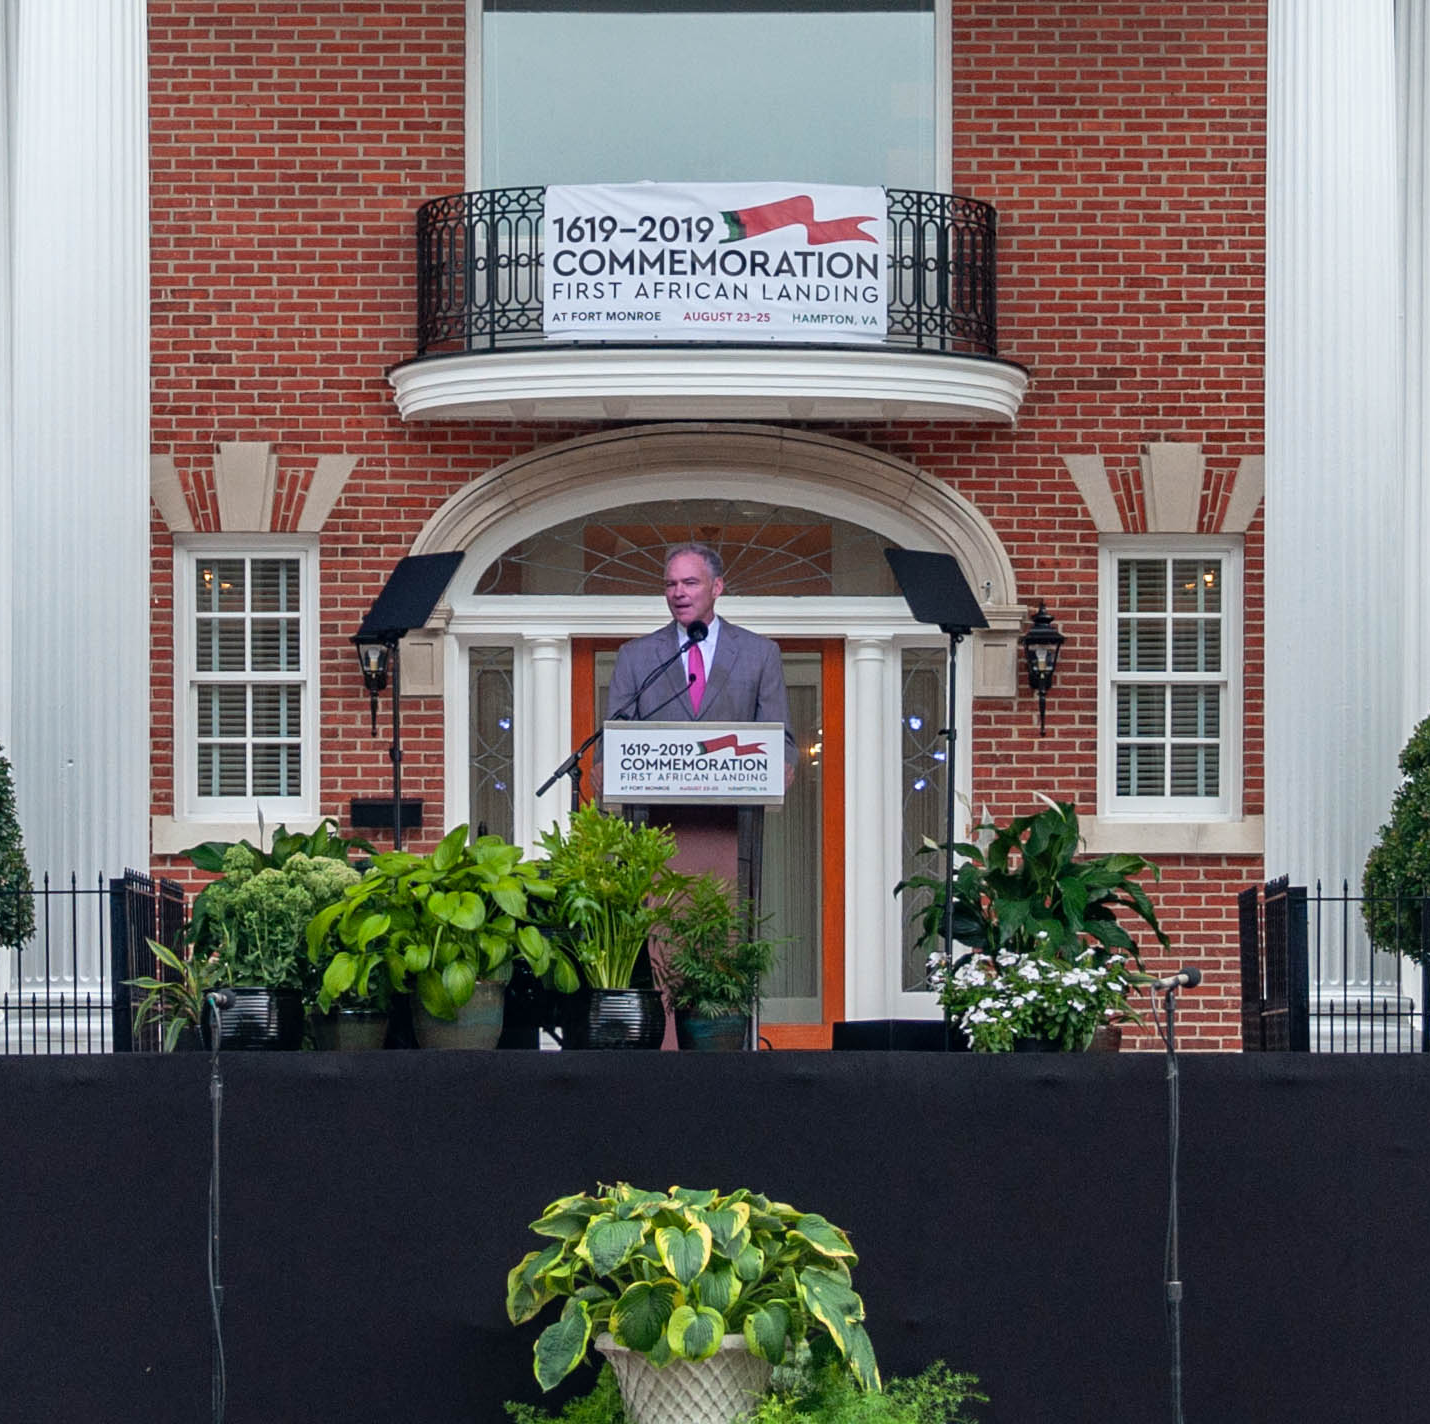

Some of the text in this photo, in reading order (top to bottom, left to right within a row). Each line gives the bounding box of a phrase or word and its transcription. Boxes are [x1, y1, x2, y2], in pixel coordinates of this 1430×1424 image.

[552, 215, 714, 243] 1619-2019
[552, 248, 879, 280] COMMEMORATION
[552, 281, 879, 303] FIRST AFRICAN LANDING
[552, 311, 662, 322] AT FORT MONROE
[683, 311, 771, 323] AUGUST 23-25
[792, 313, 878, 325] HAMPTON, VA
[620, 743, 694, 756] 1619-2019
[620, 758, 768, 771] COMMEMORATION
[620, 772, 768, 782] FIRST AFRICAN LANDING
